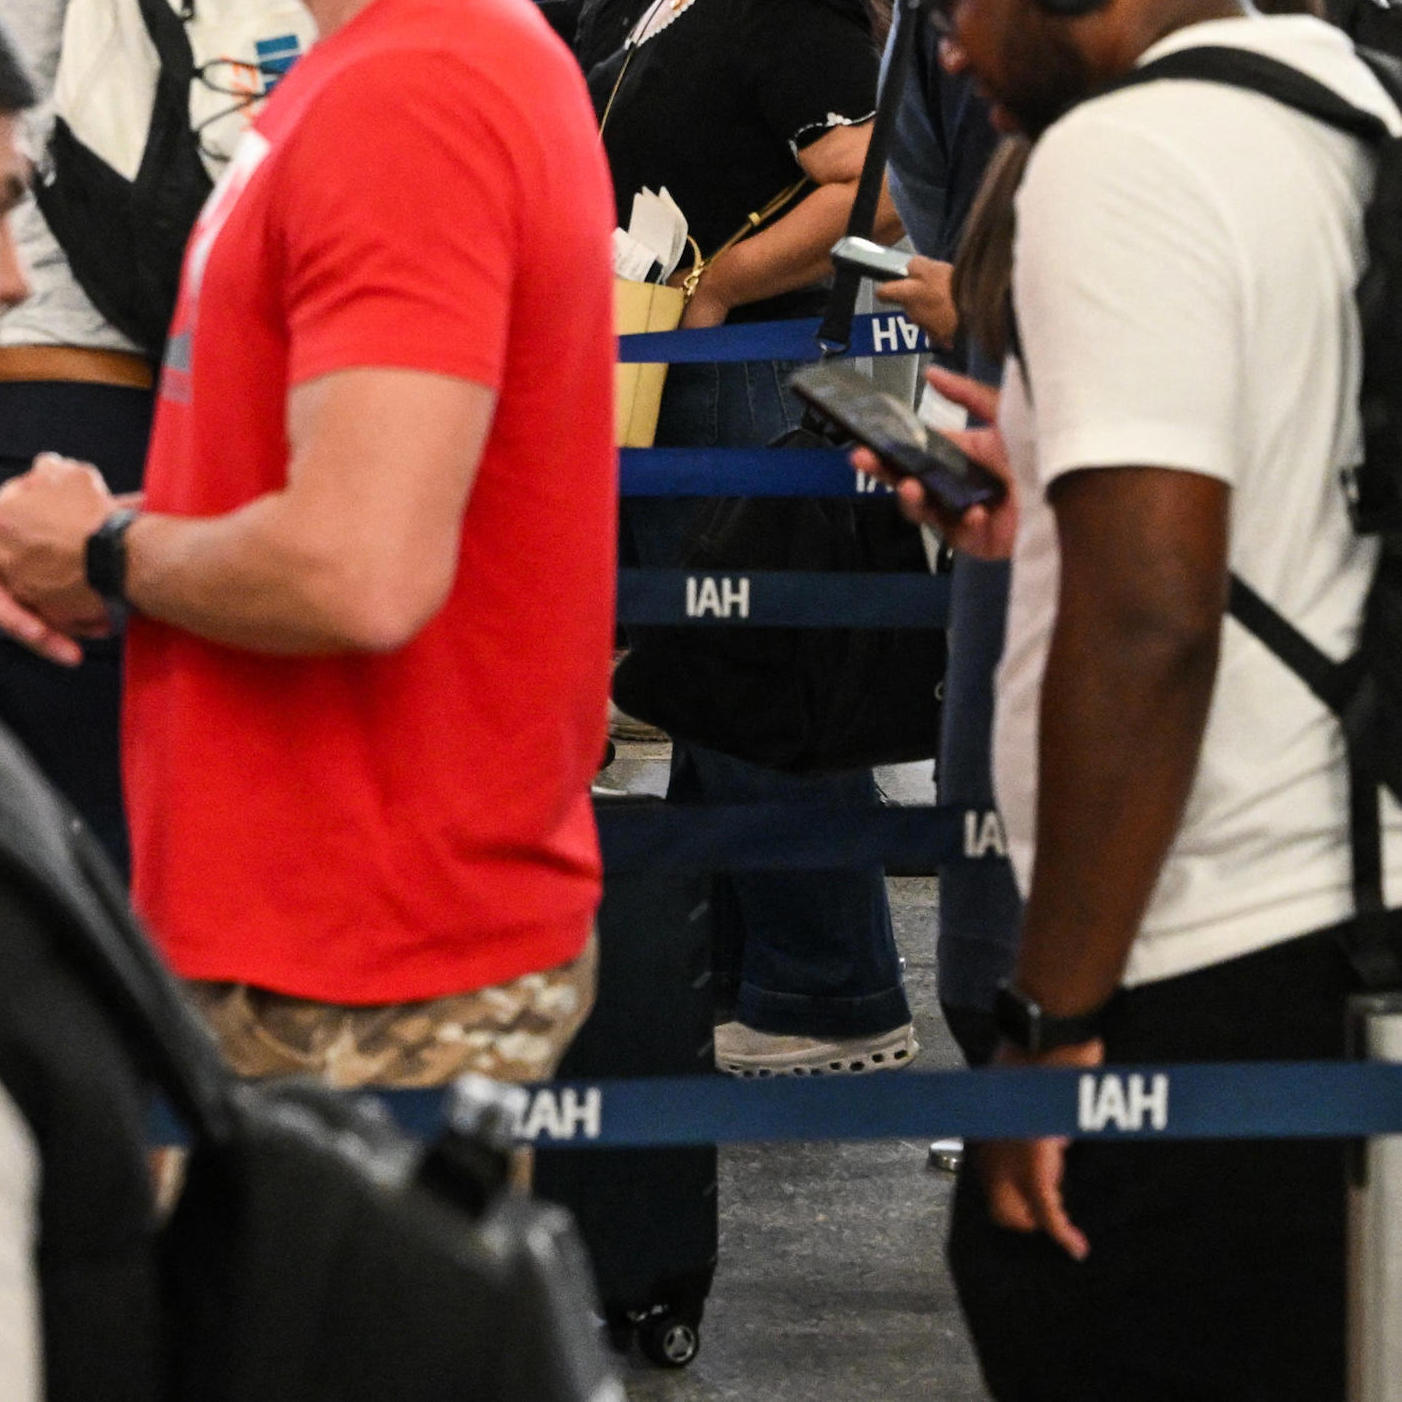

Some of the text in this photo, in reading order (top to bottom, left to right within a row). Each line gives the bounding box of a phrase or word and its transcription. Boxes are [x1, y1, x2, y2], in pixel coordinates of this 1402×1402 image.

[686, 576, 750, 619] IAH
[964, 809, 1004, 858] IA
[1078, 1073, 1168, 1133] IAH
